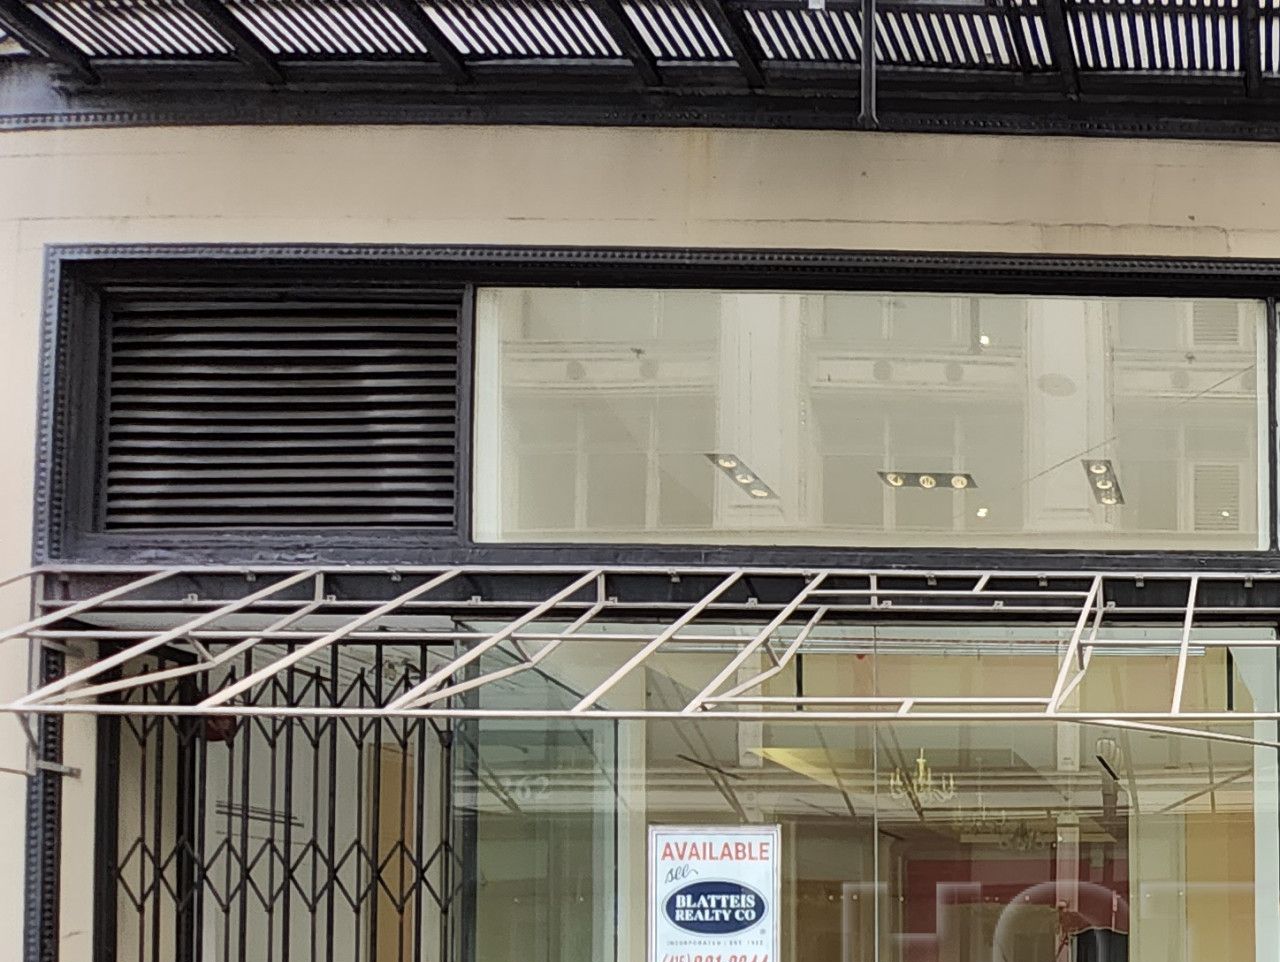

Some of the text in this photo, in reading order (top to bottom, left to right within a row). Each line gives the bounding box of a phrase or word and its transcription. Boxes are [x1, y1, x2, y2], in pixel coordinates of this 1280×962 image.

[661, 841, 770, 861] AVAILABLE
[675, 894, 756, 909] BLATTEIS
[674, 909, 757, 922] REALTY CO
